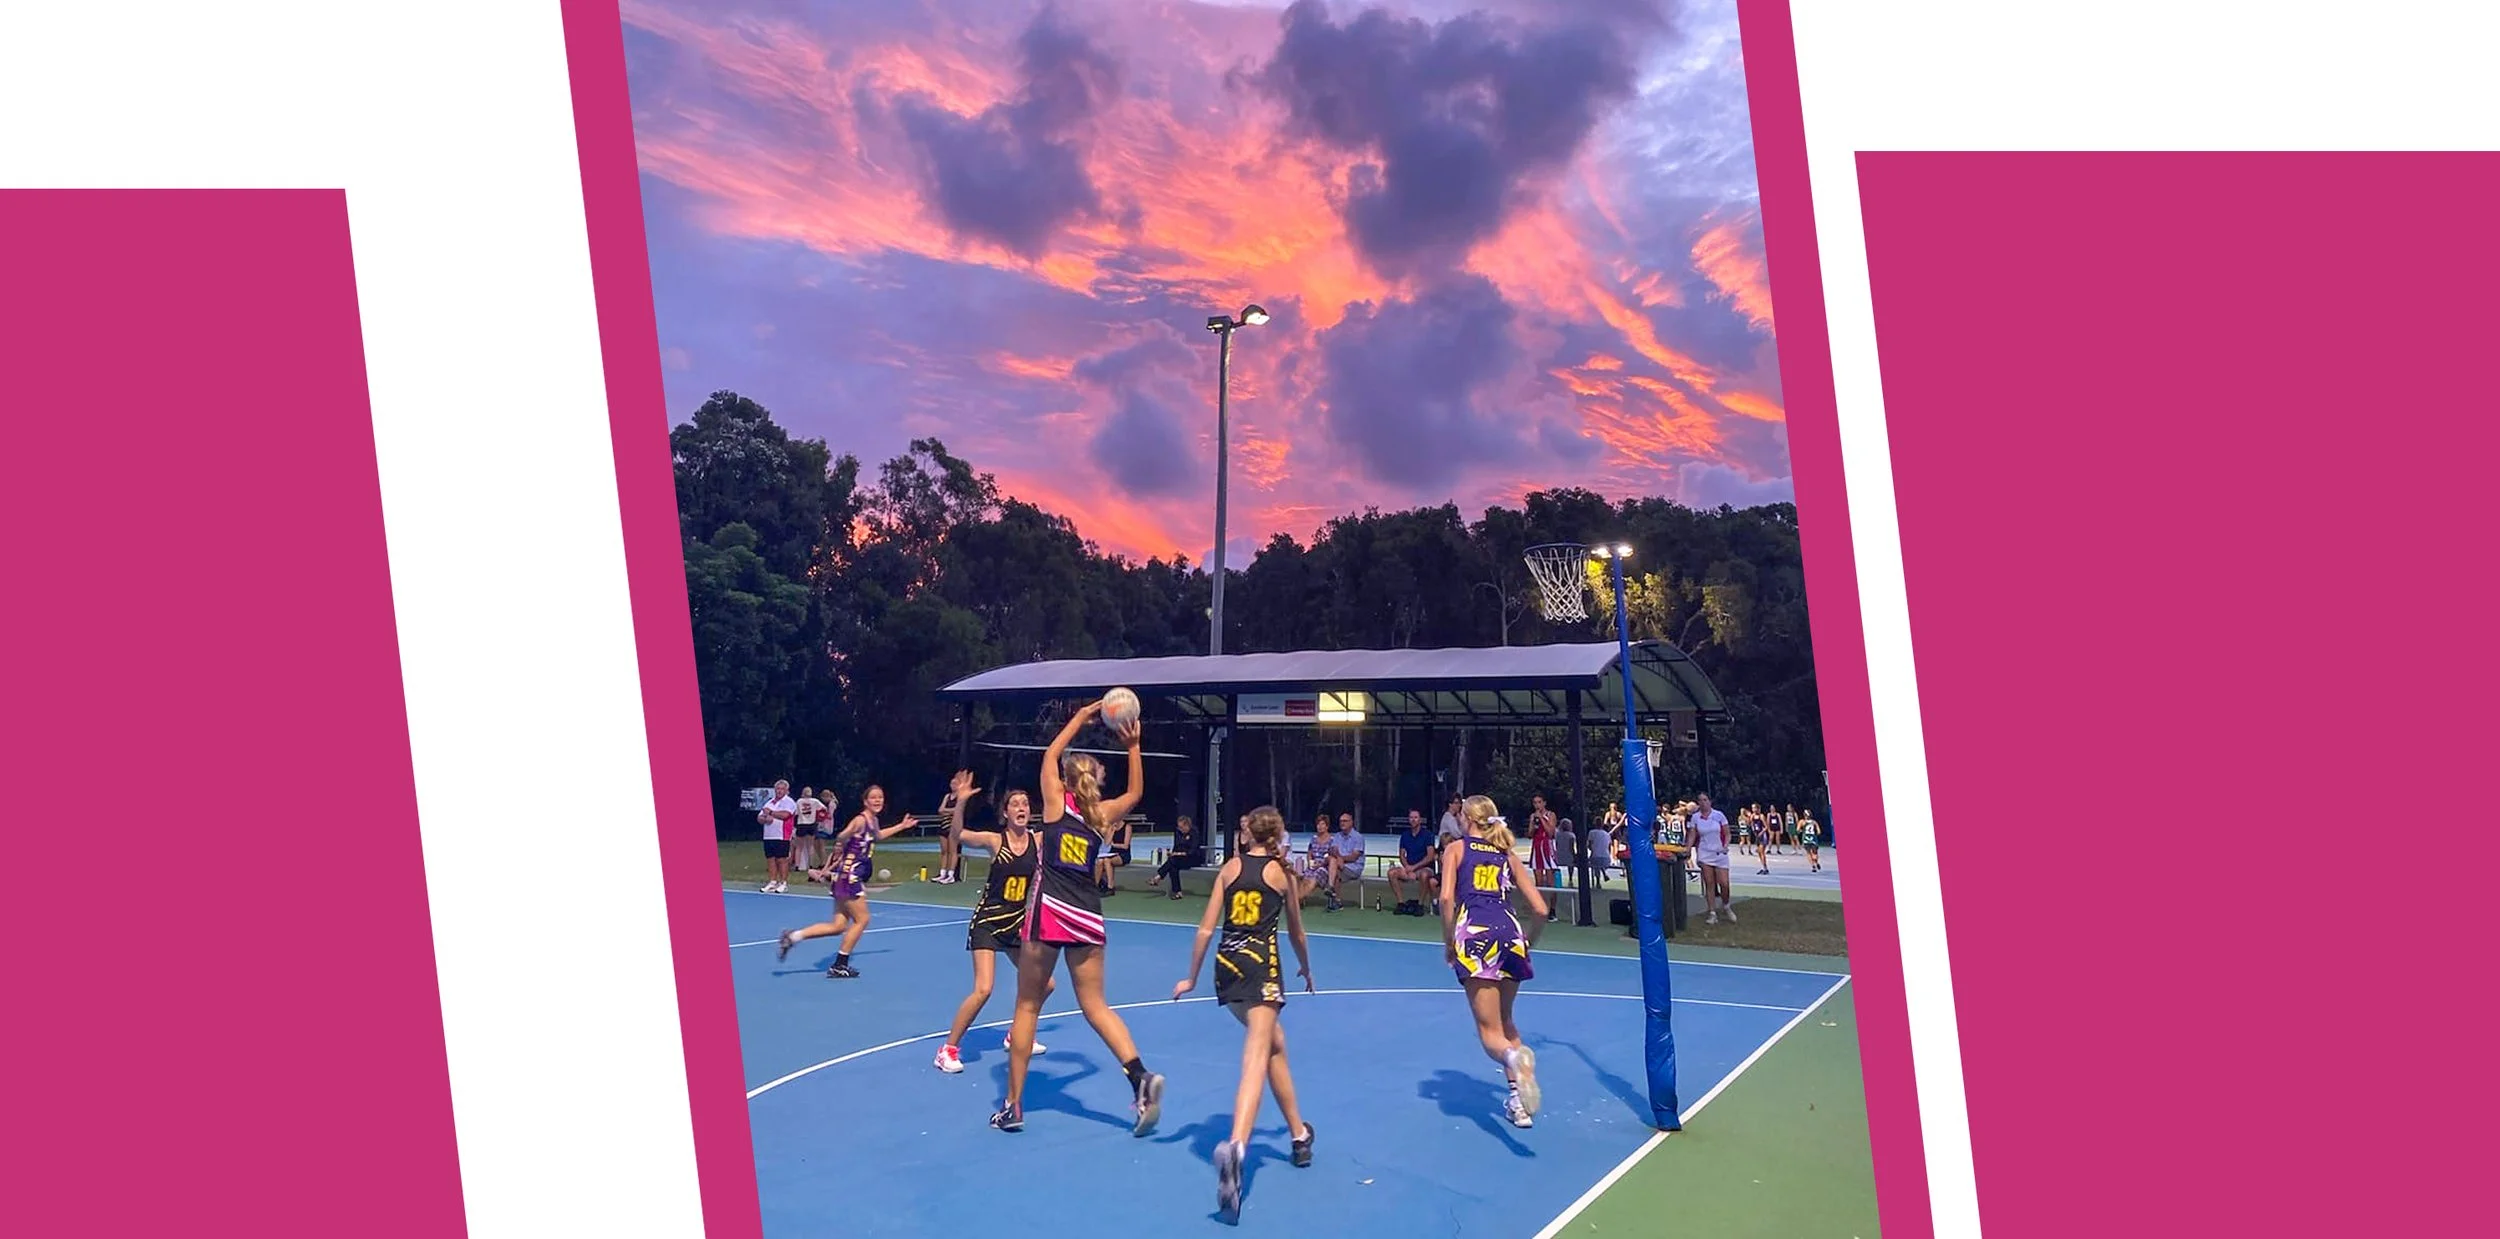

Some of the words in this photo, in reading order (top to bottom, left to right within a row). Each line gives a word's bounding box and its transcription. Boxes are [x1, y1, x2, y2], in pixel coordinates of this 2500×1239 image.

[1470, 842, 1500, 853] GEM
[1003, 875, 1027, 902] GA
[1473, 864, 1500, 891] GK
[1227, 889, 1263, 926] GS
